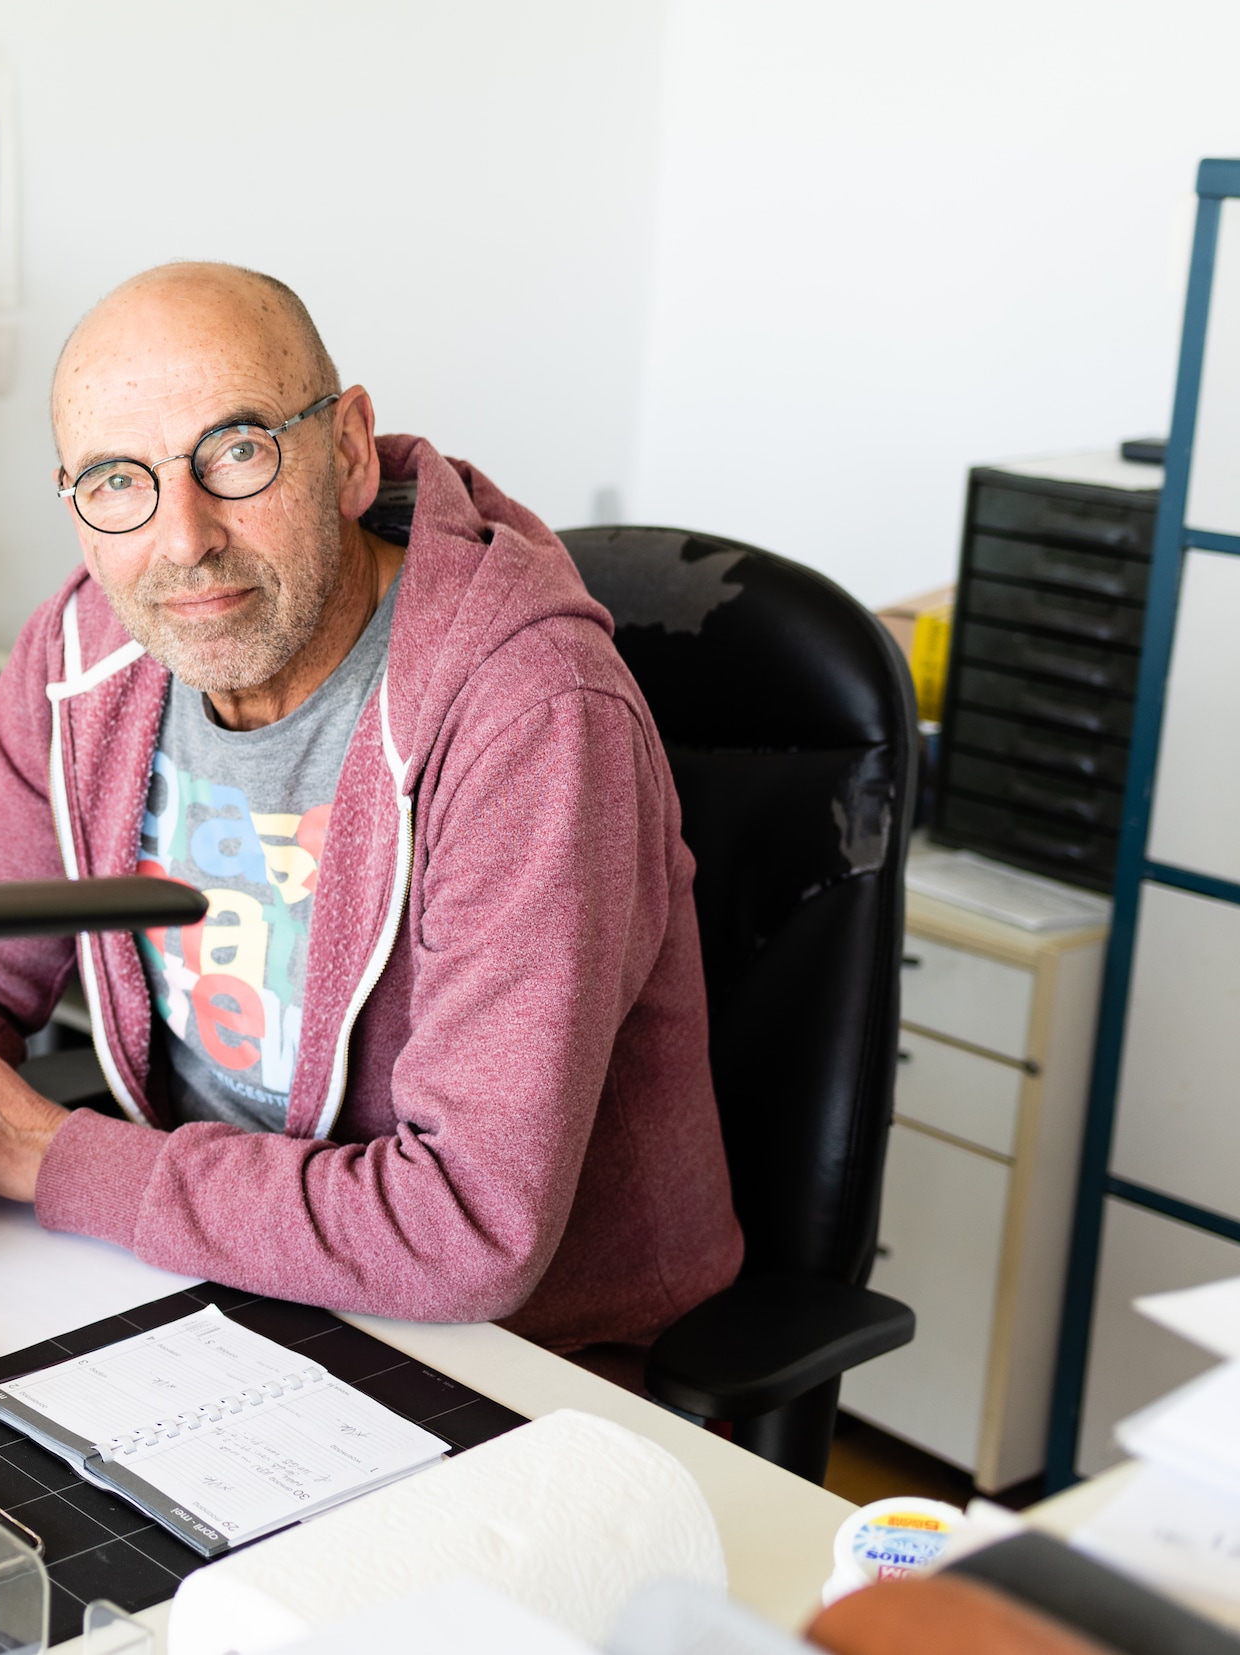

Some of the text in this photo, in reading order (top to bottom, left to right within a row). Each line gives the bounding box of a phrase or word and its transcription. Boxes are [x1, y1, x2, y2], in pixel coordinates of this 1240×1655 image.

[293, 1489, 309, 1499] 30
[171, 1508, 192, 1520] mei
[192, 1502, 238, 1531] 29 maandag
[192, 1522, 220, 1541] april
[865, 1549, 930, 1567] entos
